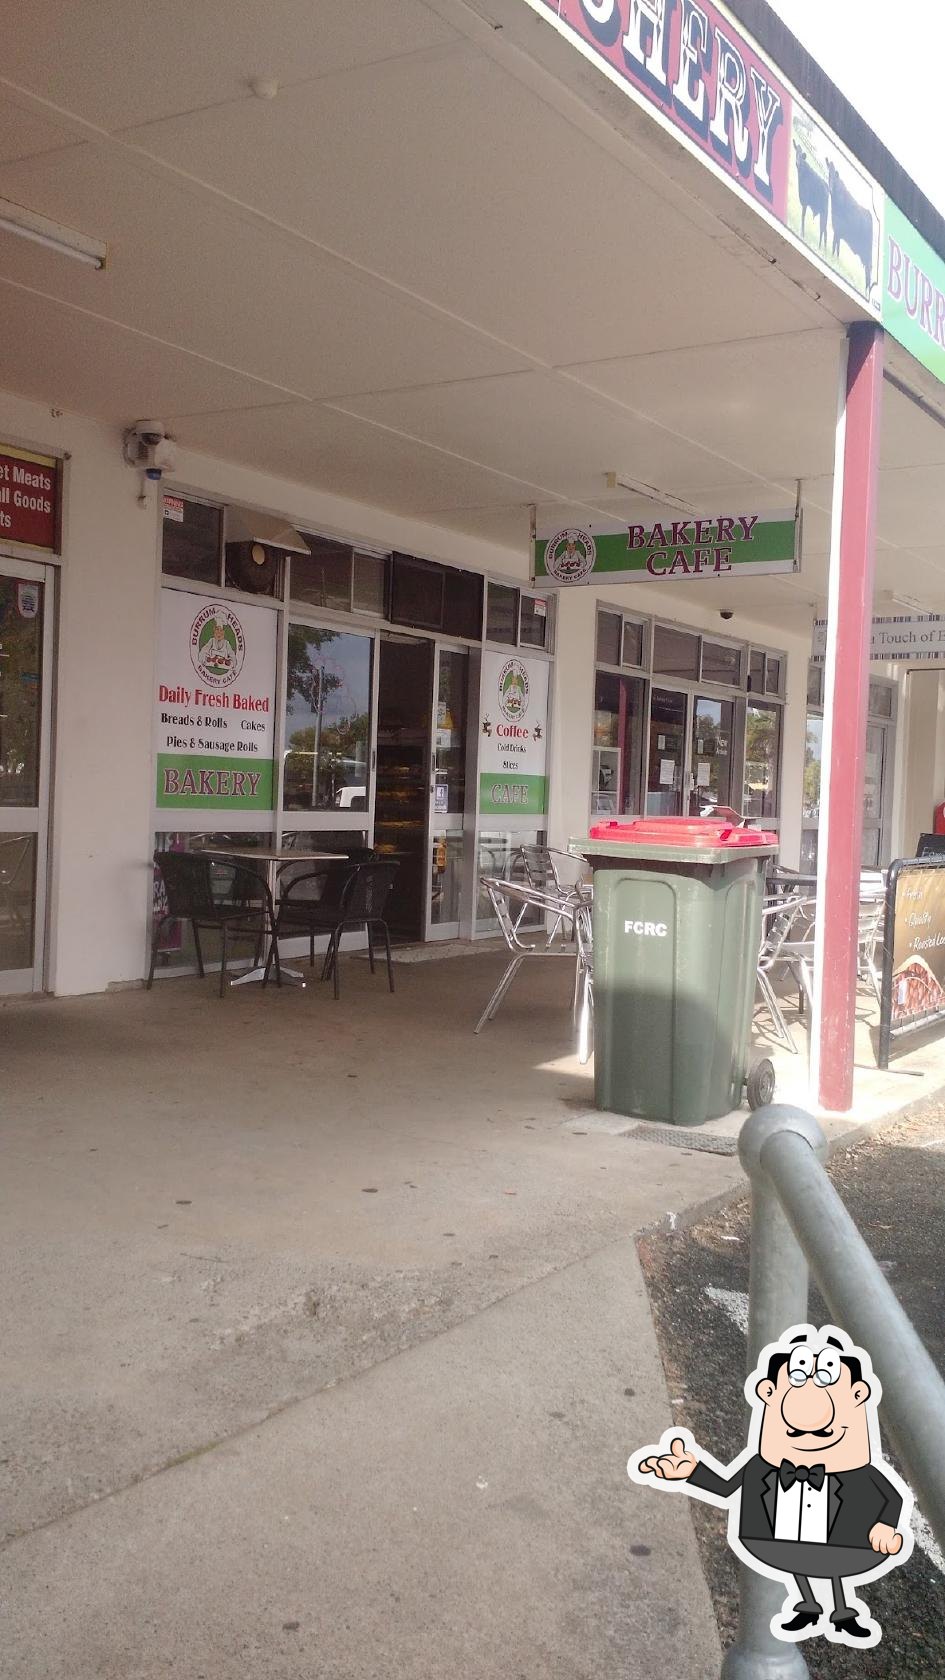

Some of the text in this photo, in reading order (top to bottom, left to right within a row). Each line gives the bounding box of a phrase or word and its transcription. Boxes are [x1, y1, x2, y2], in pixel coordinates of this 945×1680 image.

[579, 0, 784, 205] HERY
[13, 466, 51, 490] Meats
[13, 490, 51, 513] Goods
[627, 516, 759, 550] BAKERY
[646, 547, 733, 576] CAFE
[192, 607, 243, 652] BURRUM HEADS
[879, 631, 916, 644] Touch
[920, 630, 936, 642] of
[159, 685, 269, 713] Daily Fresh Baked
[160, 712, 266, 732] Breads & Rolls Cakes
[496, 723, 529, 739] Coffee
[166, 736, 258, 753] Pies & Sausage Rolls
[163, 768, 261, 797] BAKERY
[490, 784, 530, 806] CAFE
[624, 920, 668, 937] FCRC
